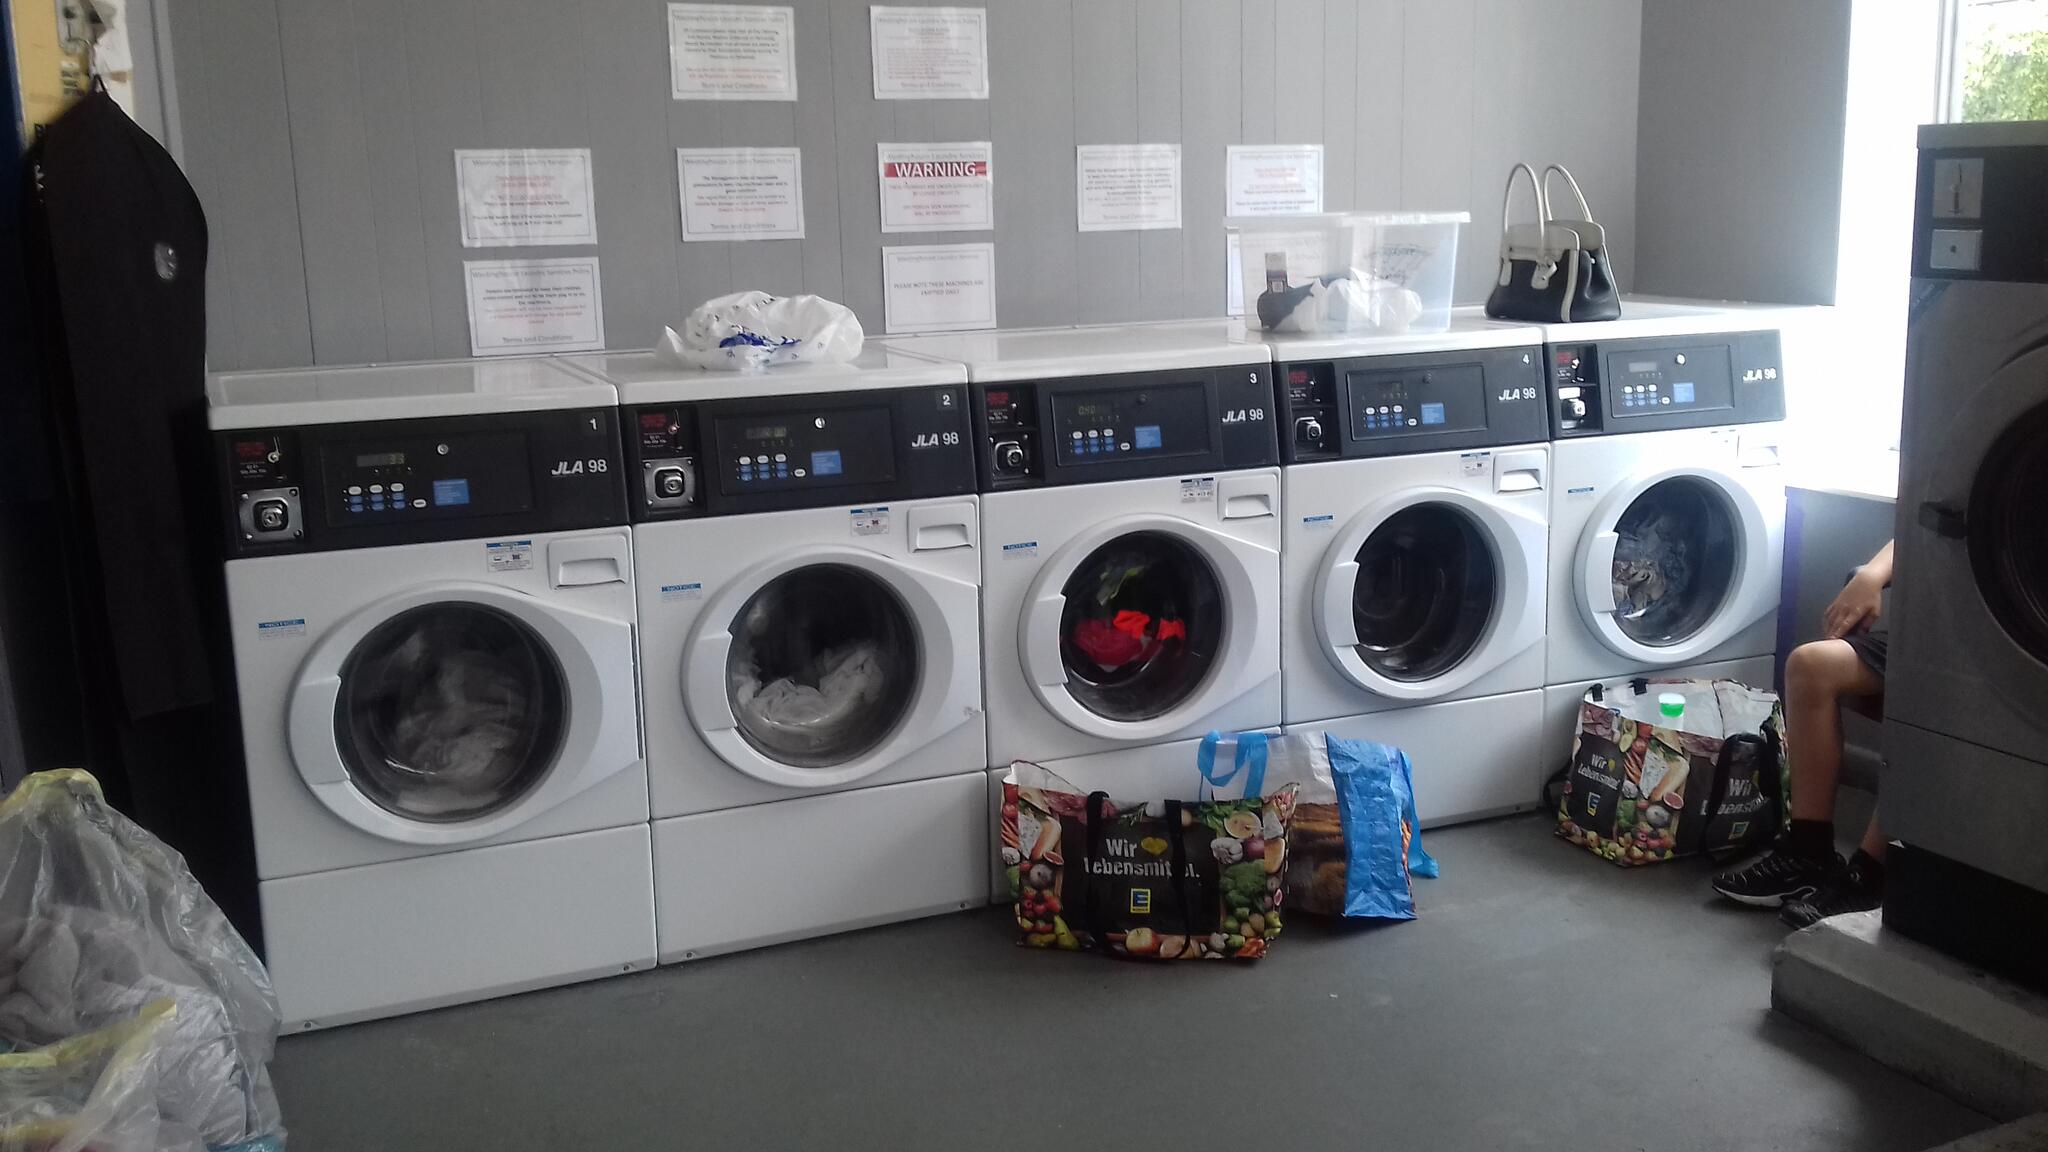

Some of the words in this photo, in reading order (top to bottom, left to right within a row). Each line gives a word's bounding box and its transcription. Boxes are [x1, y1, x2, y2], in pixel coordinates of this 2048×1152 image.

[894, 162, 977, 178] WARNING
[1522, 354, 1530, 365] 4
[1249, 372, 1258, 384] 3
[942, 394, 952, 406] 2
[1498, 388, 1521, 401] JLA
[1522, 387, 1536, 399] 98
[1221, 409, 1246, 423] JLA
[1249, 408, 1264, 421] 98
[589, 418, 597, 431] 1
[911, 433, 939, 448] JLA
[942, 431, 960, 446] 98
[551, 460, 584, 476] JLA
[588, 458, 608, 473] 98
[1105, 838, 1138, 858] Wir
